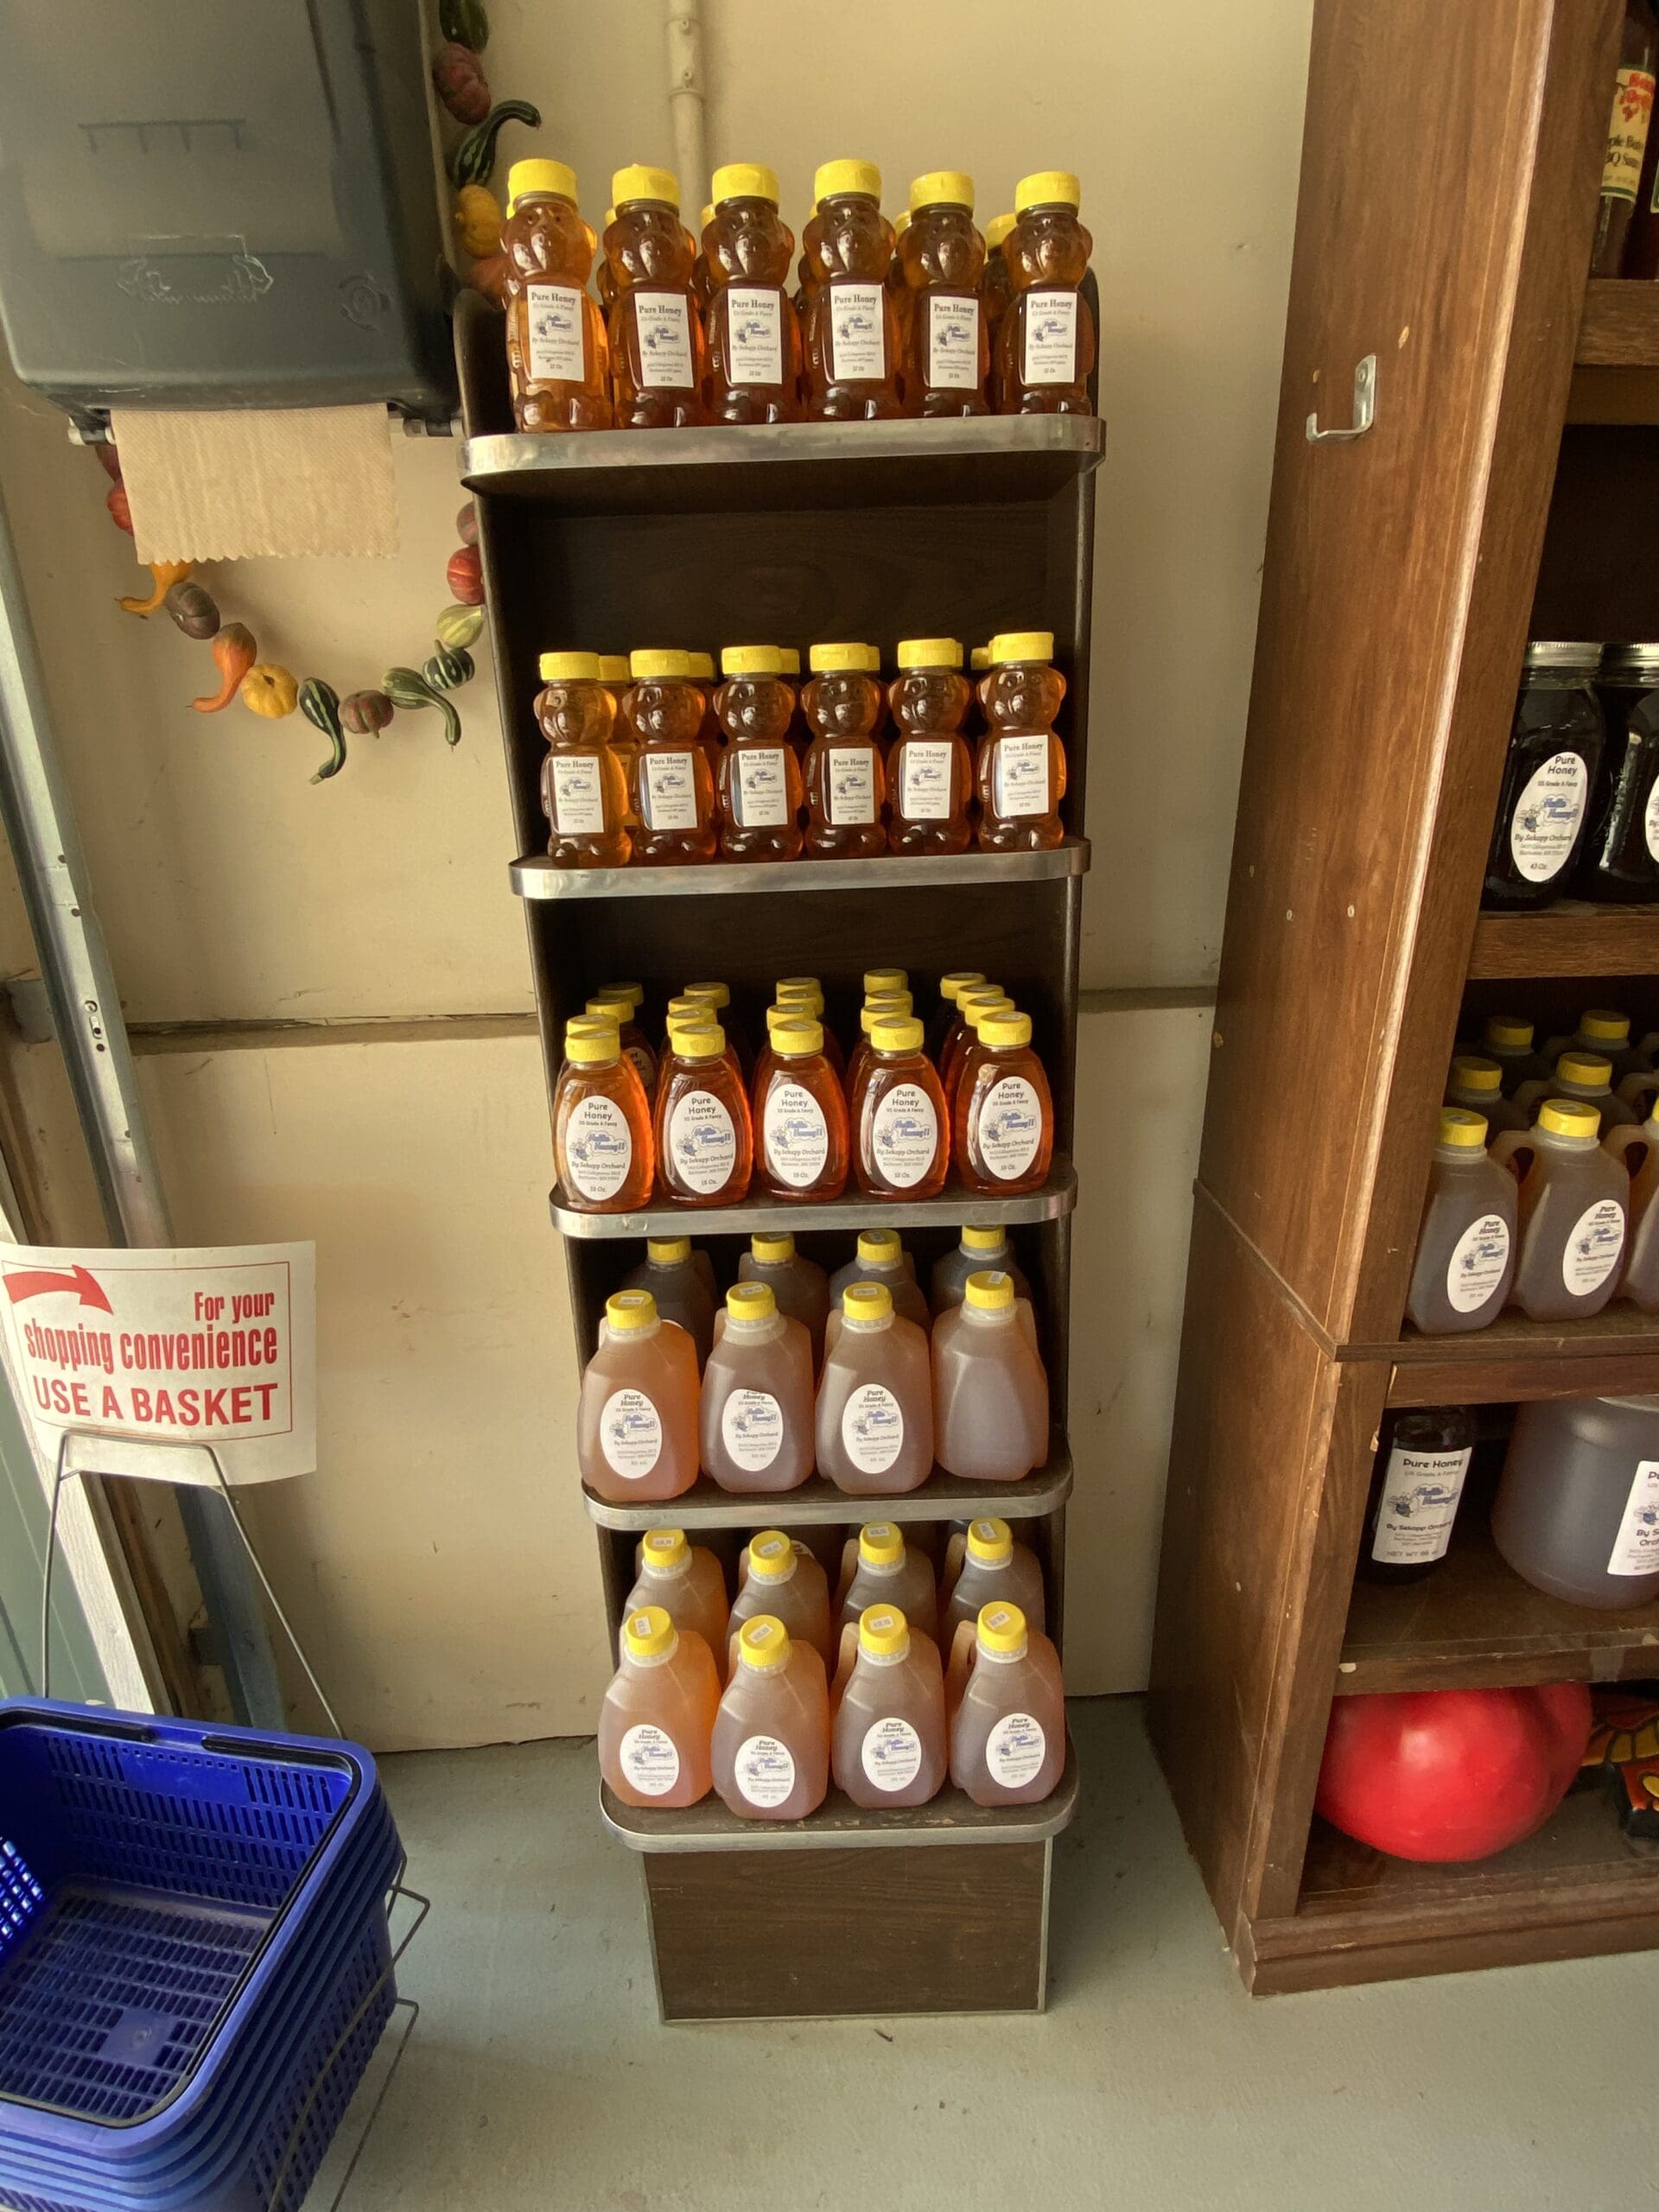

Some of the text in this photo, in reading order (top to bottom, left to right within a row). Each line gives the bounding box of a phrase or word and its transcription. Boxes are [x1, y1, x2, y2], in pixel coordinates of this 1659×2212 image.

[531, 292, 575, 306] Pure Honey
[835, 295, 877, 304] Pure Honey
[1050, 299, 1071, 309] Honey
[752, 300, 774, 310] Honey
[953, 304, 974, 315] Honey
[658, 305, 682, 316] Honey
[925, 750, 947, 759] Honey
[850, 759, 868, 767] Honey
[1548, 766, 1577, 776] Honey
[781, 1099, 808, 1108] Honey
[585, 1111, 612, 1121] Honey
[194, 1292, 275, 1324] For your
[24, 1318, 277, 1375] shopping convenience
[33, 1376, 278, 1426] USE A BASKET
[1403, 1459, 1463, 1468] Pure Honey
